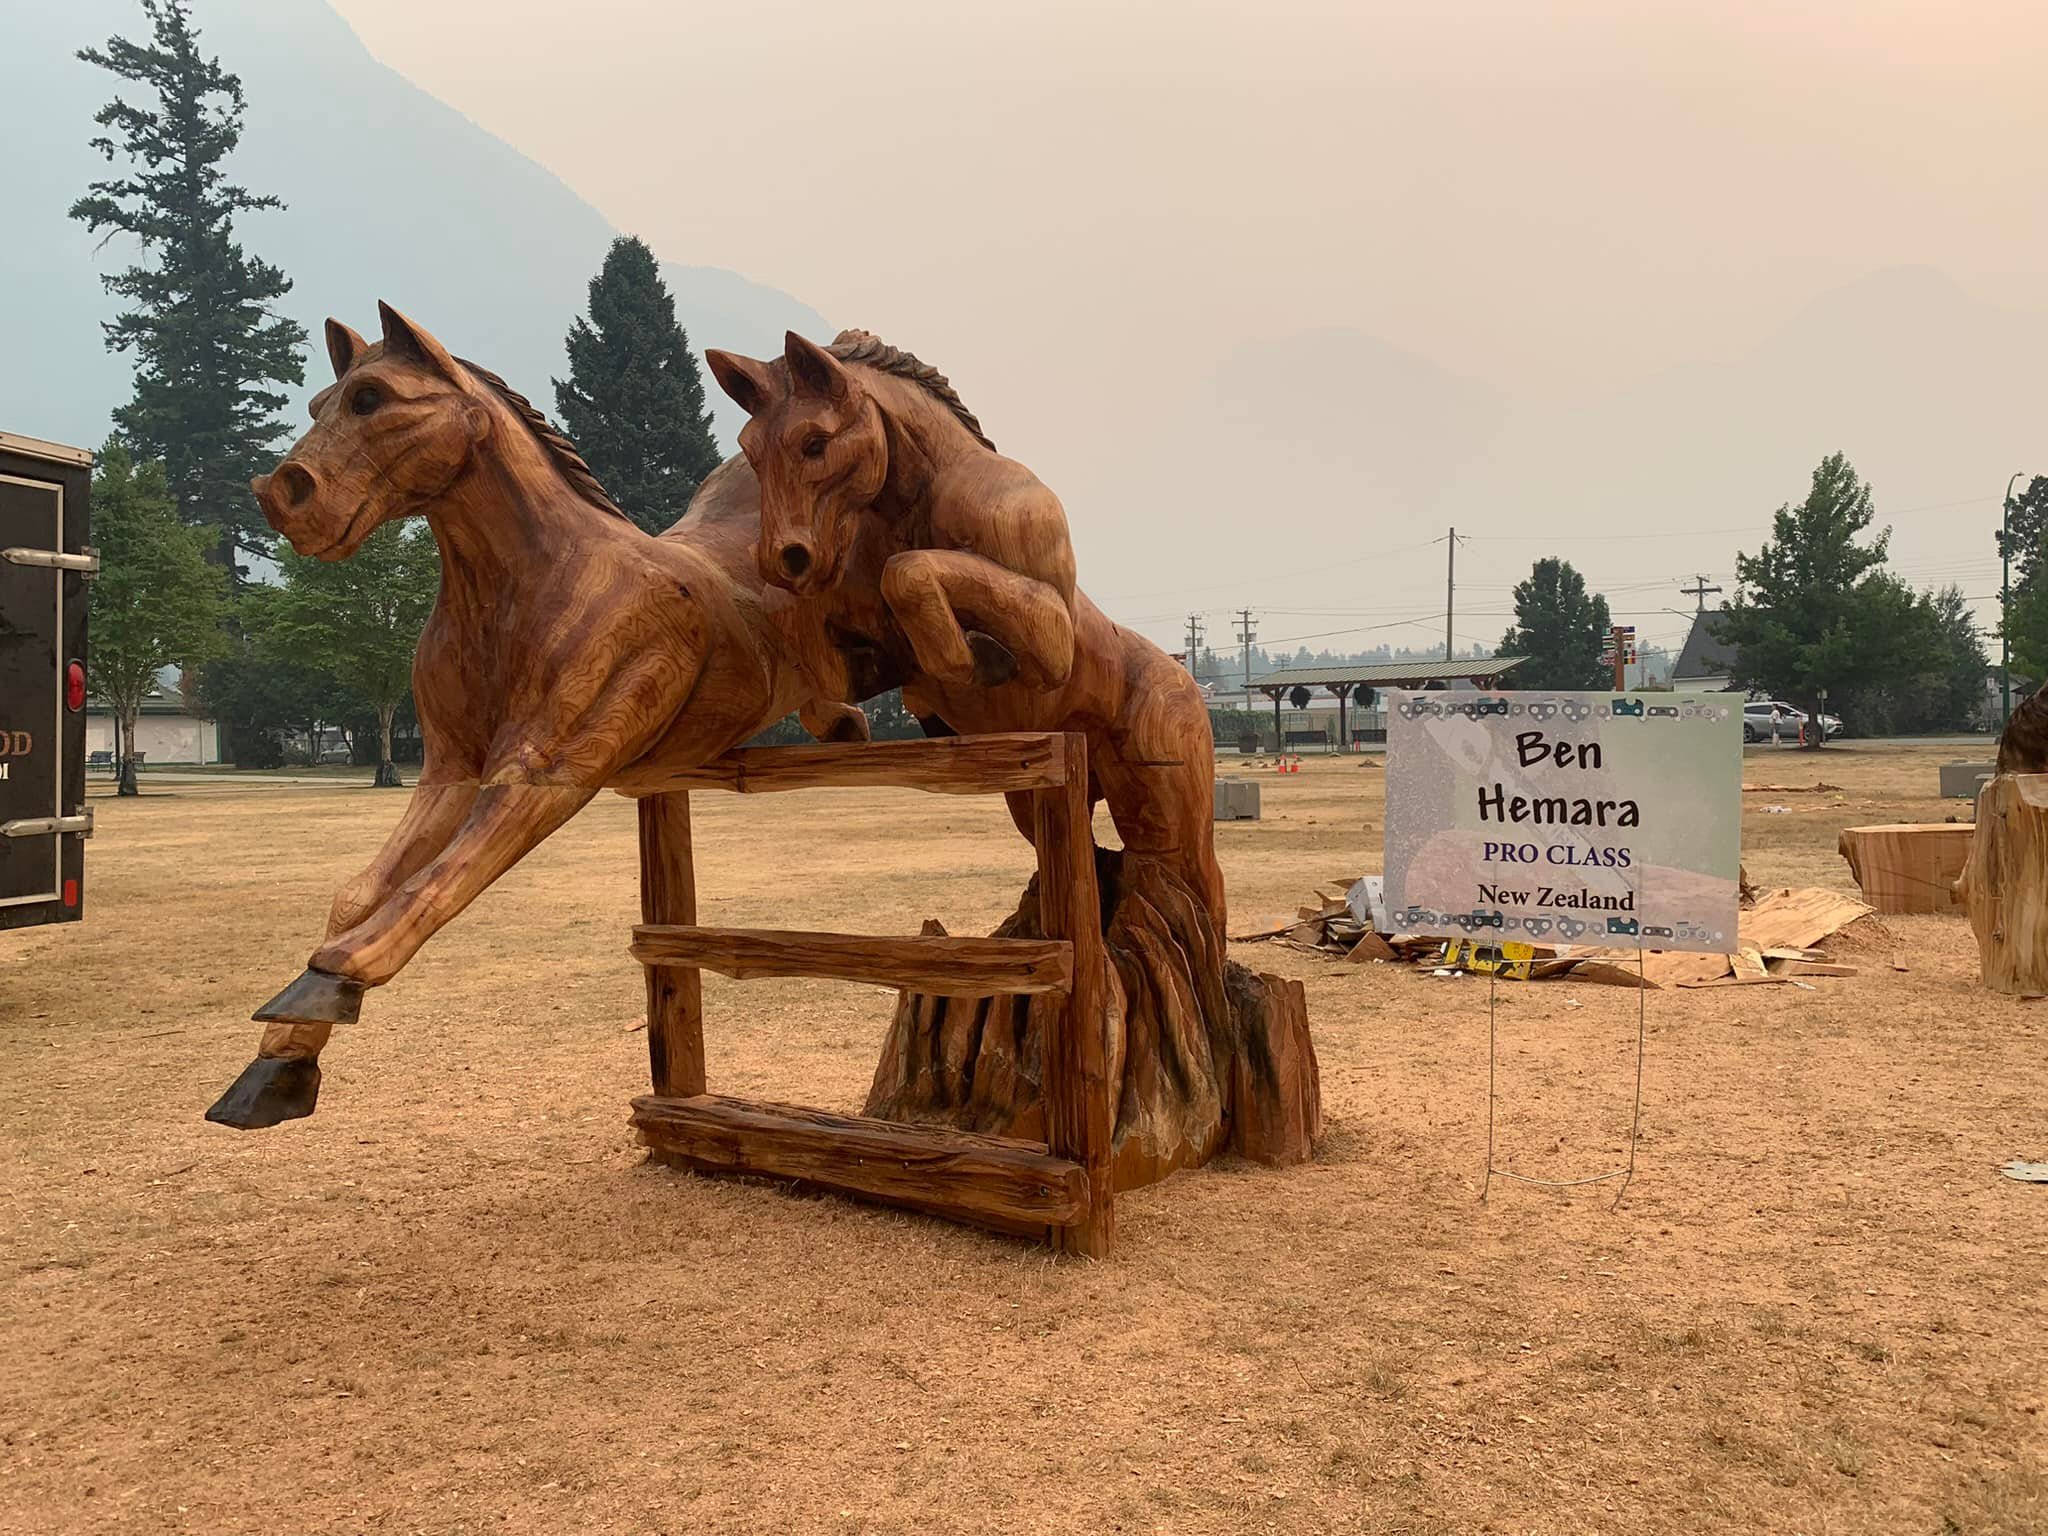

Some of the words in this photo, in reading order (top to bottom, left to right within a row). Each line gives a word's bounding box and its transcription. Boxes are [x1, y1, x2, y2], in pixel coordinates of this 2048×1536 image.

[1515, 731, 1602, 770] Ben
[1477, 783, 1640, 828] Hemara
[1482, 842, 1539, 864] PRO
[1546, 845, 1632, 868] CLASS
[1477, 884, 1531, 906] New
[1536, 887, 1635, 912] Zealand
